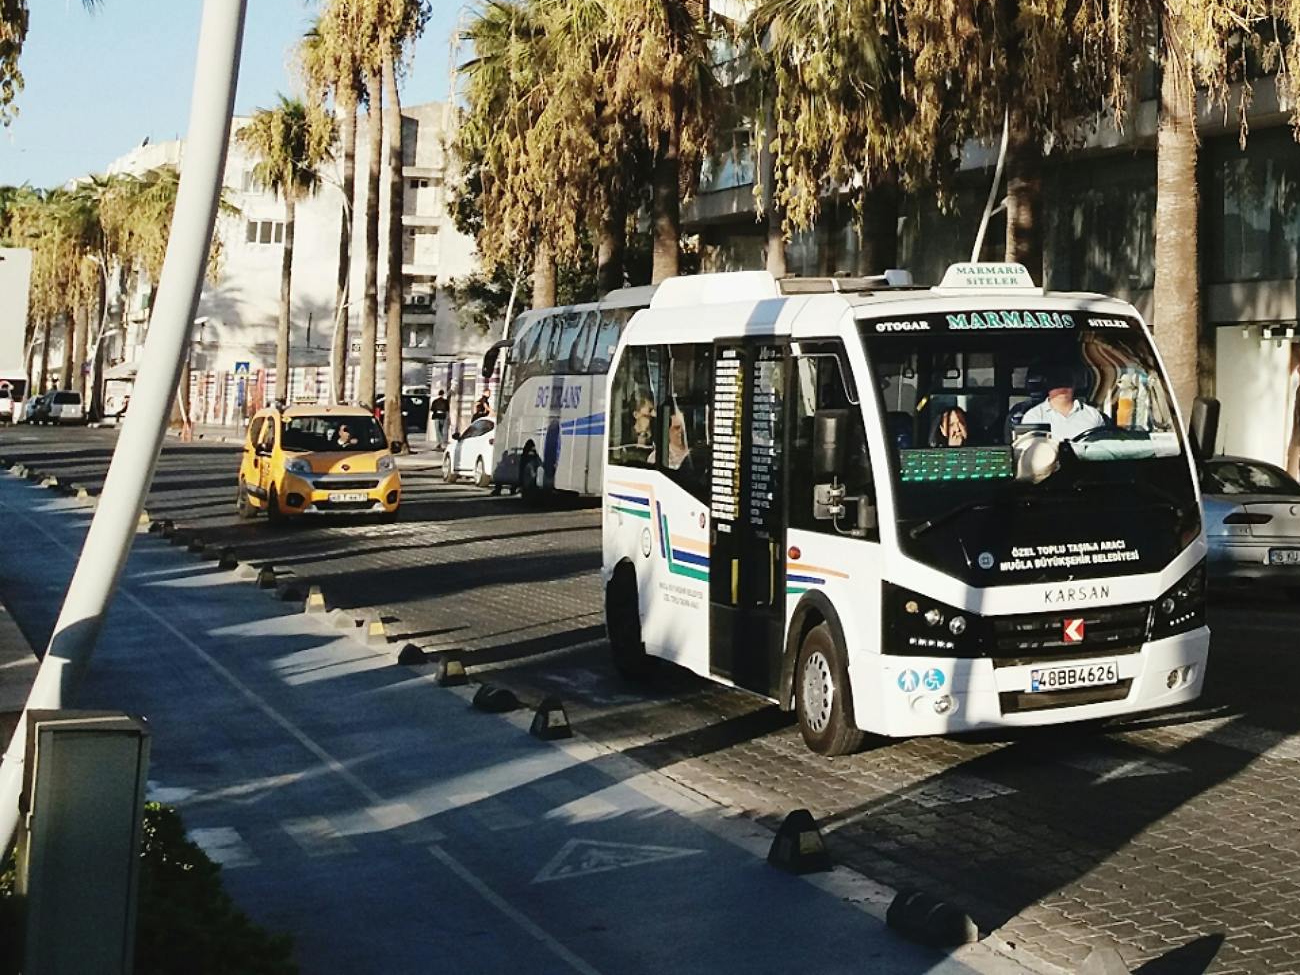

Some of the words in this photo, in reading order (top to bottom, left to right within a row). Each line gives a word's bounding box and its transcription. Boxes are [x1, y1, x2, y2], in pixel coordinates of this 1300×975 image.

[876, 321, 930, 332] OTOGAR
[1011, 546, 1036, 557] ÖZEL
[1037, 544, 1067, 556] TOPLU
[1000, 558, 1033, 571] MUĞLA
[1044, 585, 1110, 603] KARSAN
